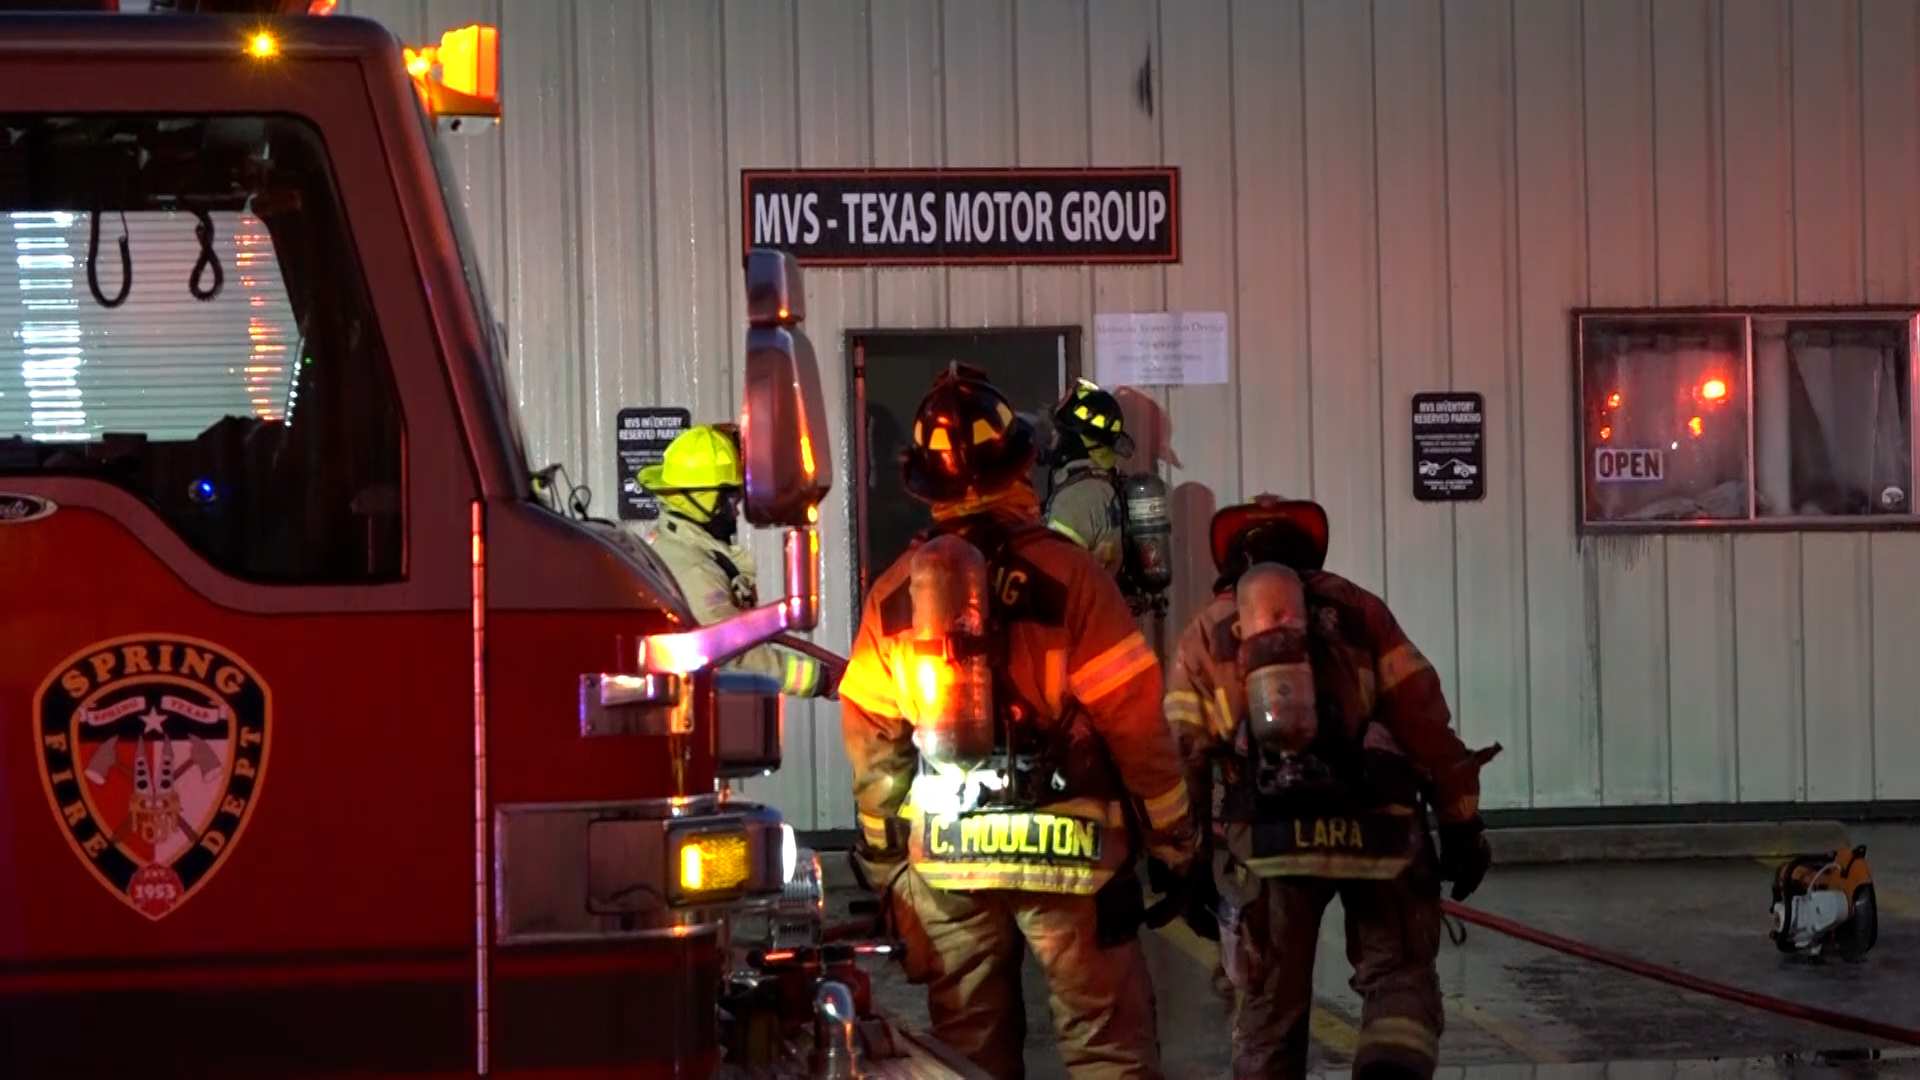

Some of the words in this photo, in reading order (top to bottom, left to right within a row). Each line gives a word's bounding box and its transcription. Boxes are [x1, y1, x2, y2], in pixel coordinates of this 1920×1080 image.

[754, 192, 820, 244] MVS
[826, 218, 838, 229] -
[842, 192, 938, 244] TEXAS
[945, 190, 1053, 243] MOTOR
[1060, 190, 1167, 242] GROUP
[1413, 413, 1450, 424] RESERVED
[1450, 412, 1482, 424] PARKING
[1419, 402, 1435, 412] MVS
[1436, 401, 1476, 412] INVENTORY
[618, 428, 656, 440] RESERVED
[624, 417, 641, 428] MVS
[1599, 451, 1660, 478] OPEN
[61, 644, 245, 698] SPRING
[45, 732, 108, 858] FIRE
[200, 726, 262, 856] DEPT
[929, 814, 955, 855] C.
[960, 813, 1095, 858] MOULTON
[1293, 817, 1364, 849] LARA
[135, 883, 177, 900] 1953
